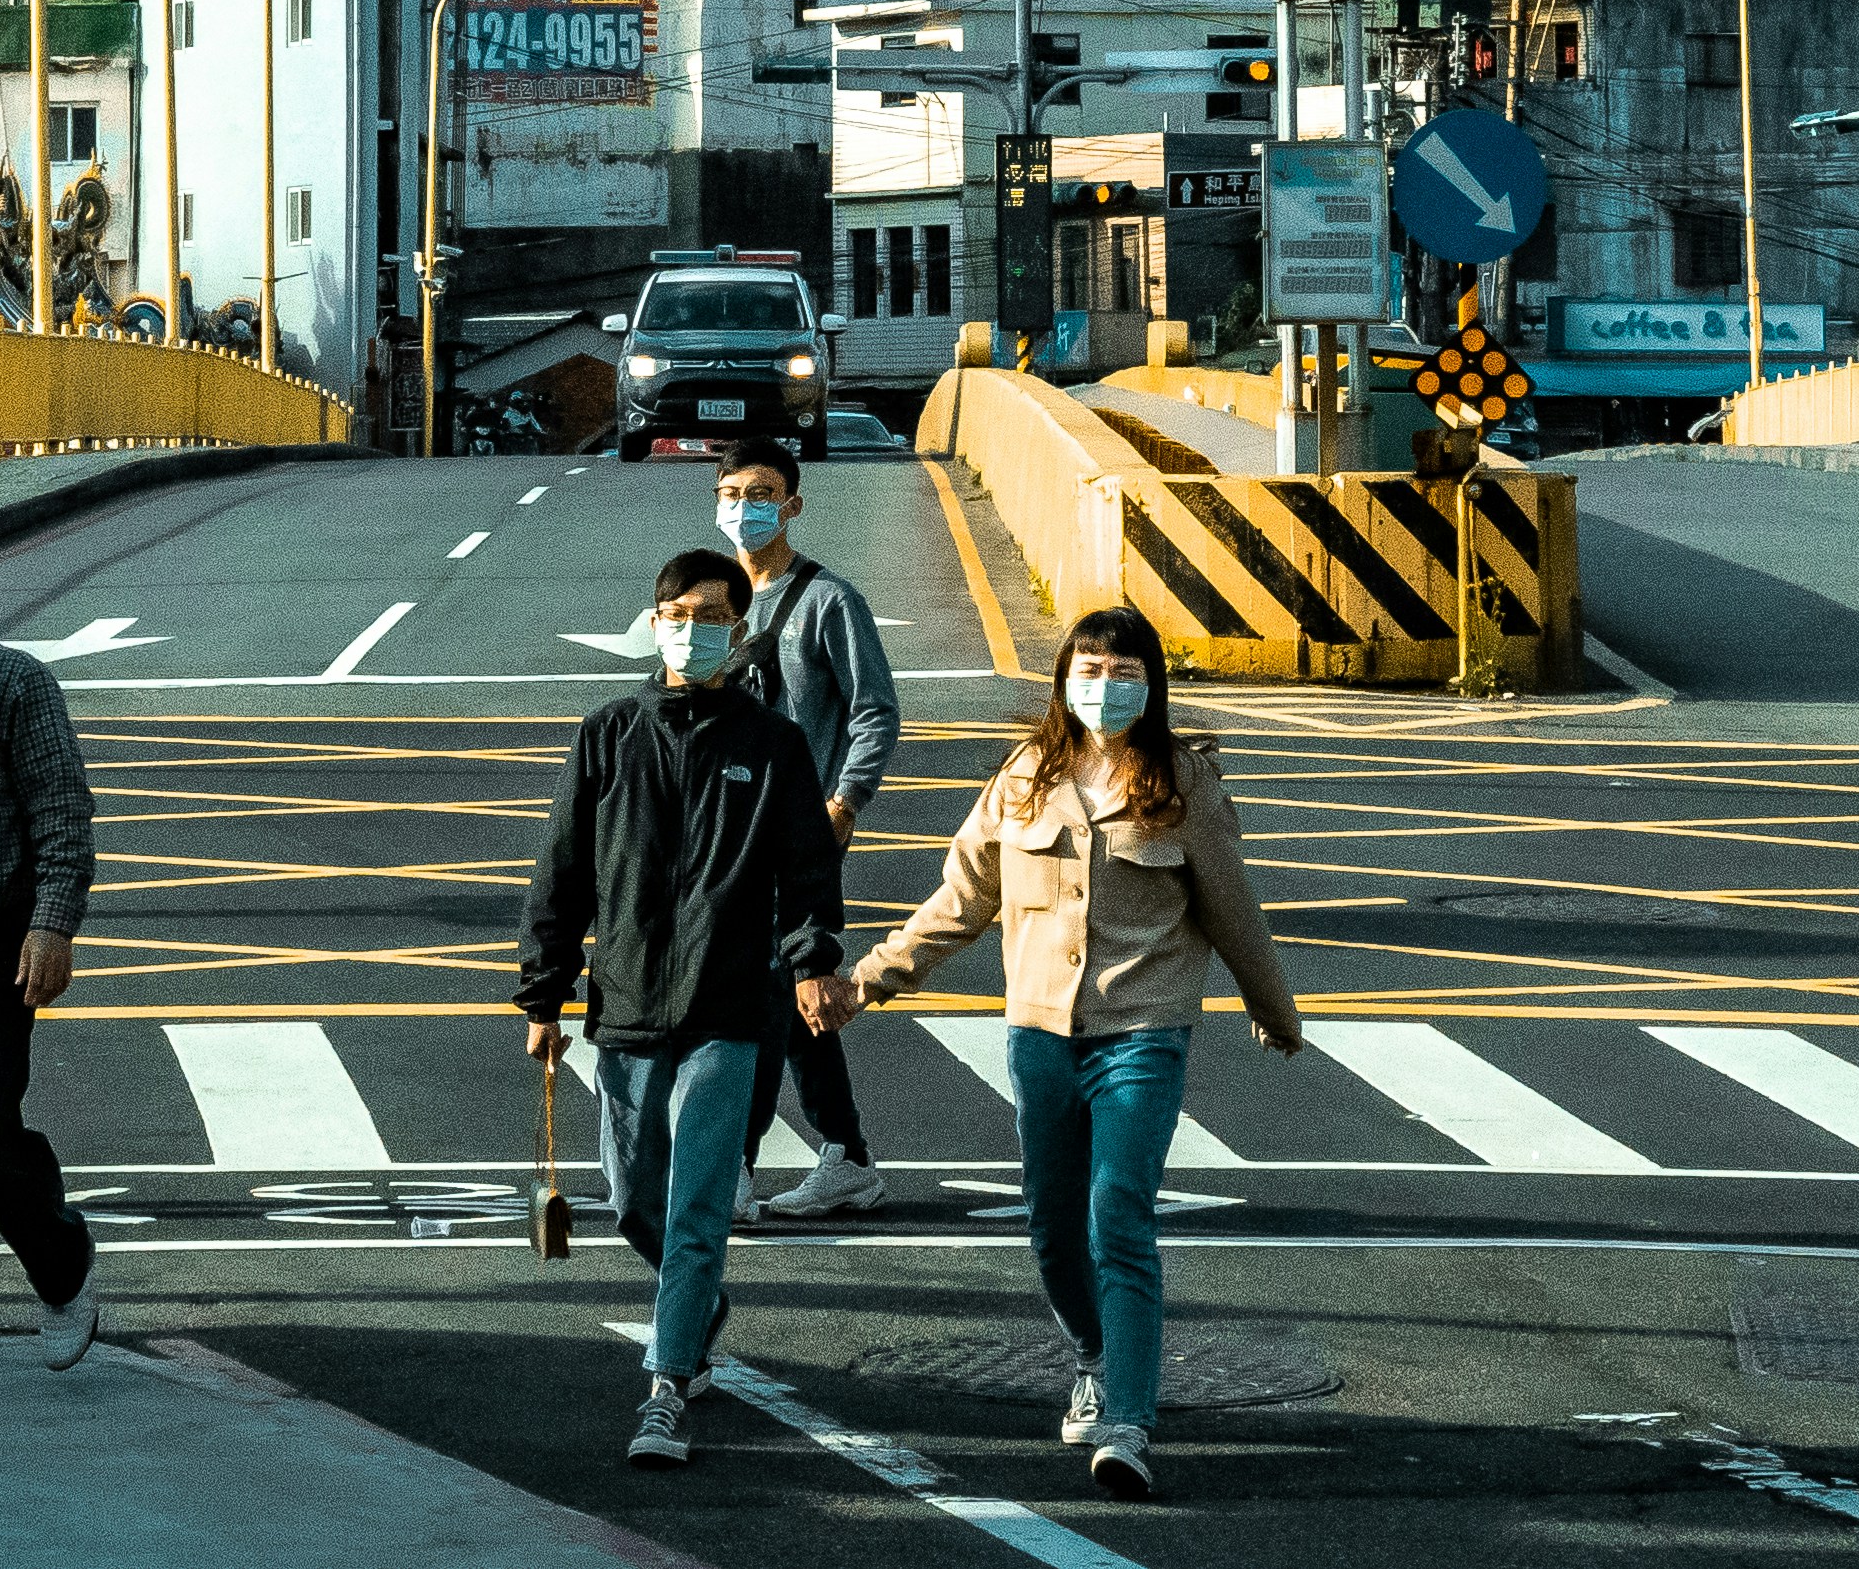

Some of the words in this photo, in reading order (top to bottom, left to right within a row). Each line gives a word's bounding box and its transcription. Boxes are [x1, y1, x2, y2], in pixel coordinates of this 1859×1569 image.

[1204, 194, 1241, 206] Heping
[1244, 193, 1263, 204] Isl
[1591, 309, 1691, 341] coffee
[1702, 309, 1727, 339] &
